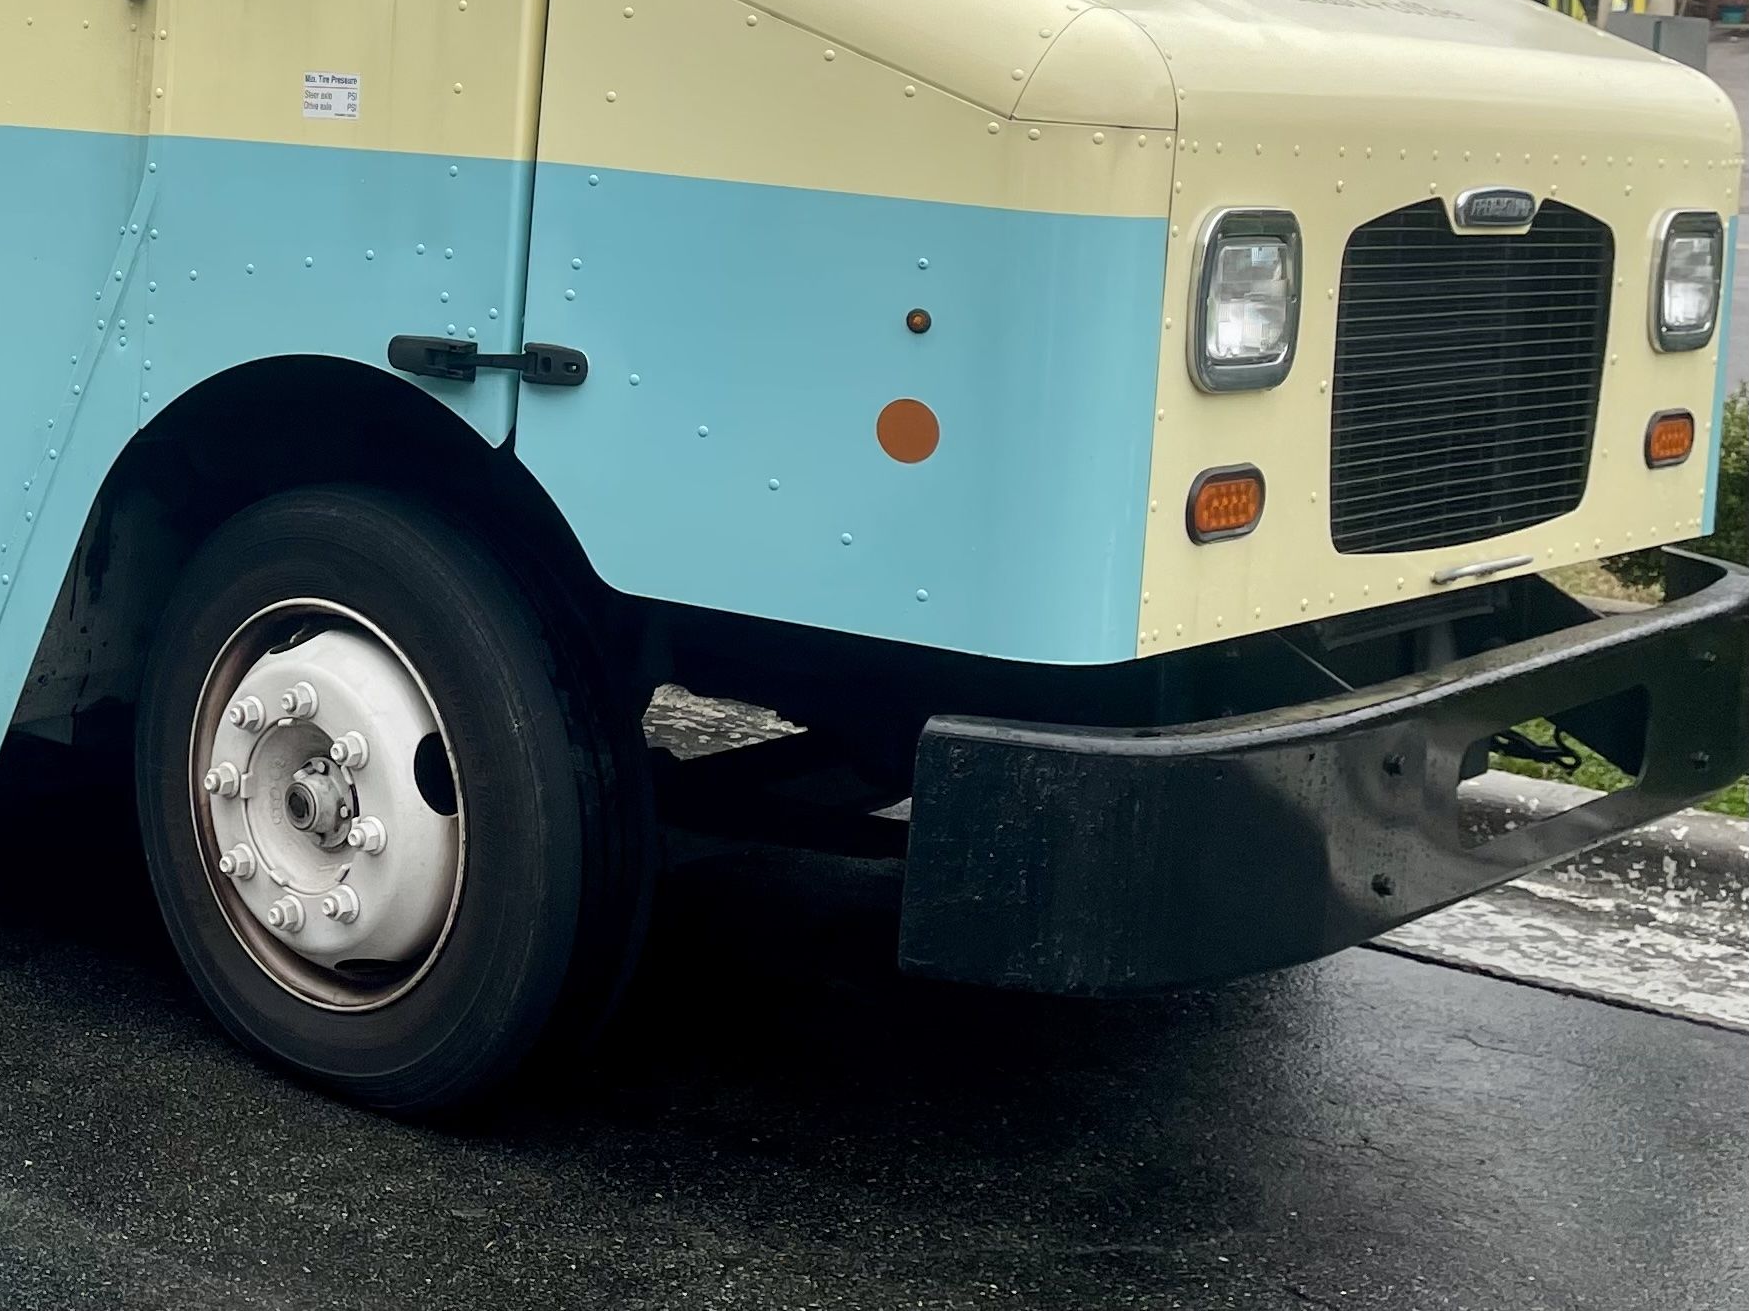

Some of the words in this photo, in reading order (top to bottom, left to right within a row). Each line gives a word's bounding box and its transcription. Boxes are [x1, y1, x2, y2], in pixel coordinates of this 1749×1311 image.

[318, 74, 330, 84] Tire
[331, 74, 358, 85] Pressure
[347, 91, 358, 101] PSI
[347, 103, 357, 113] PSI
